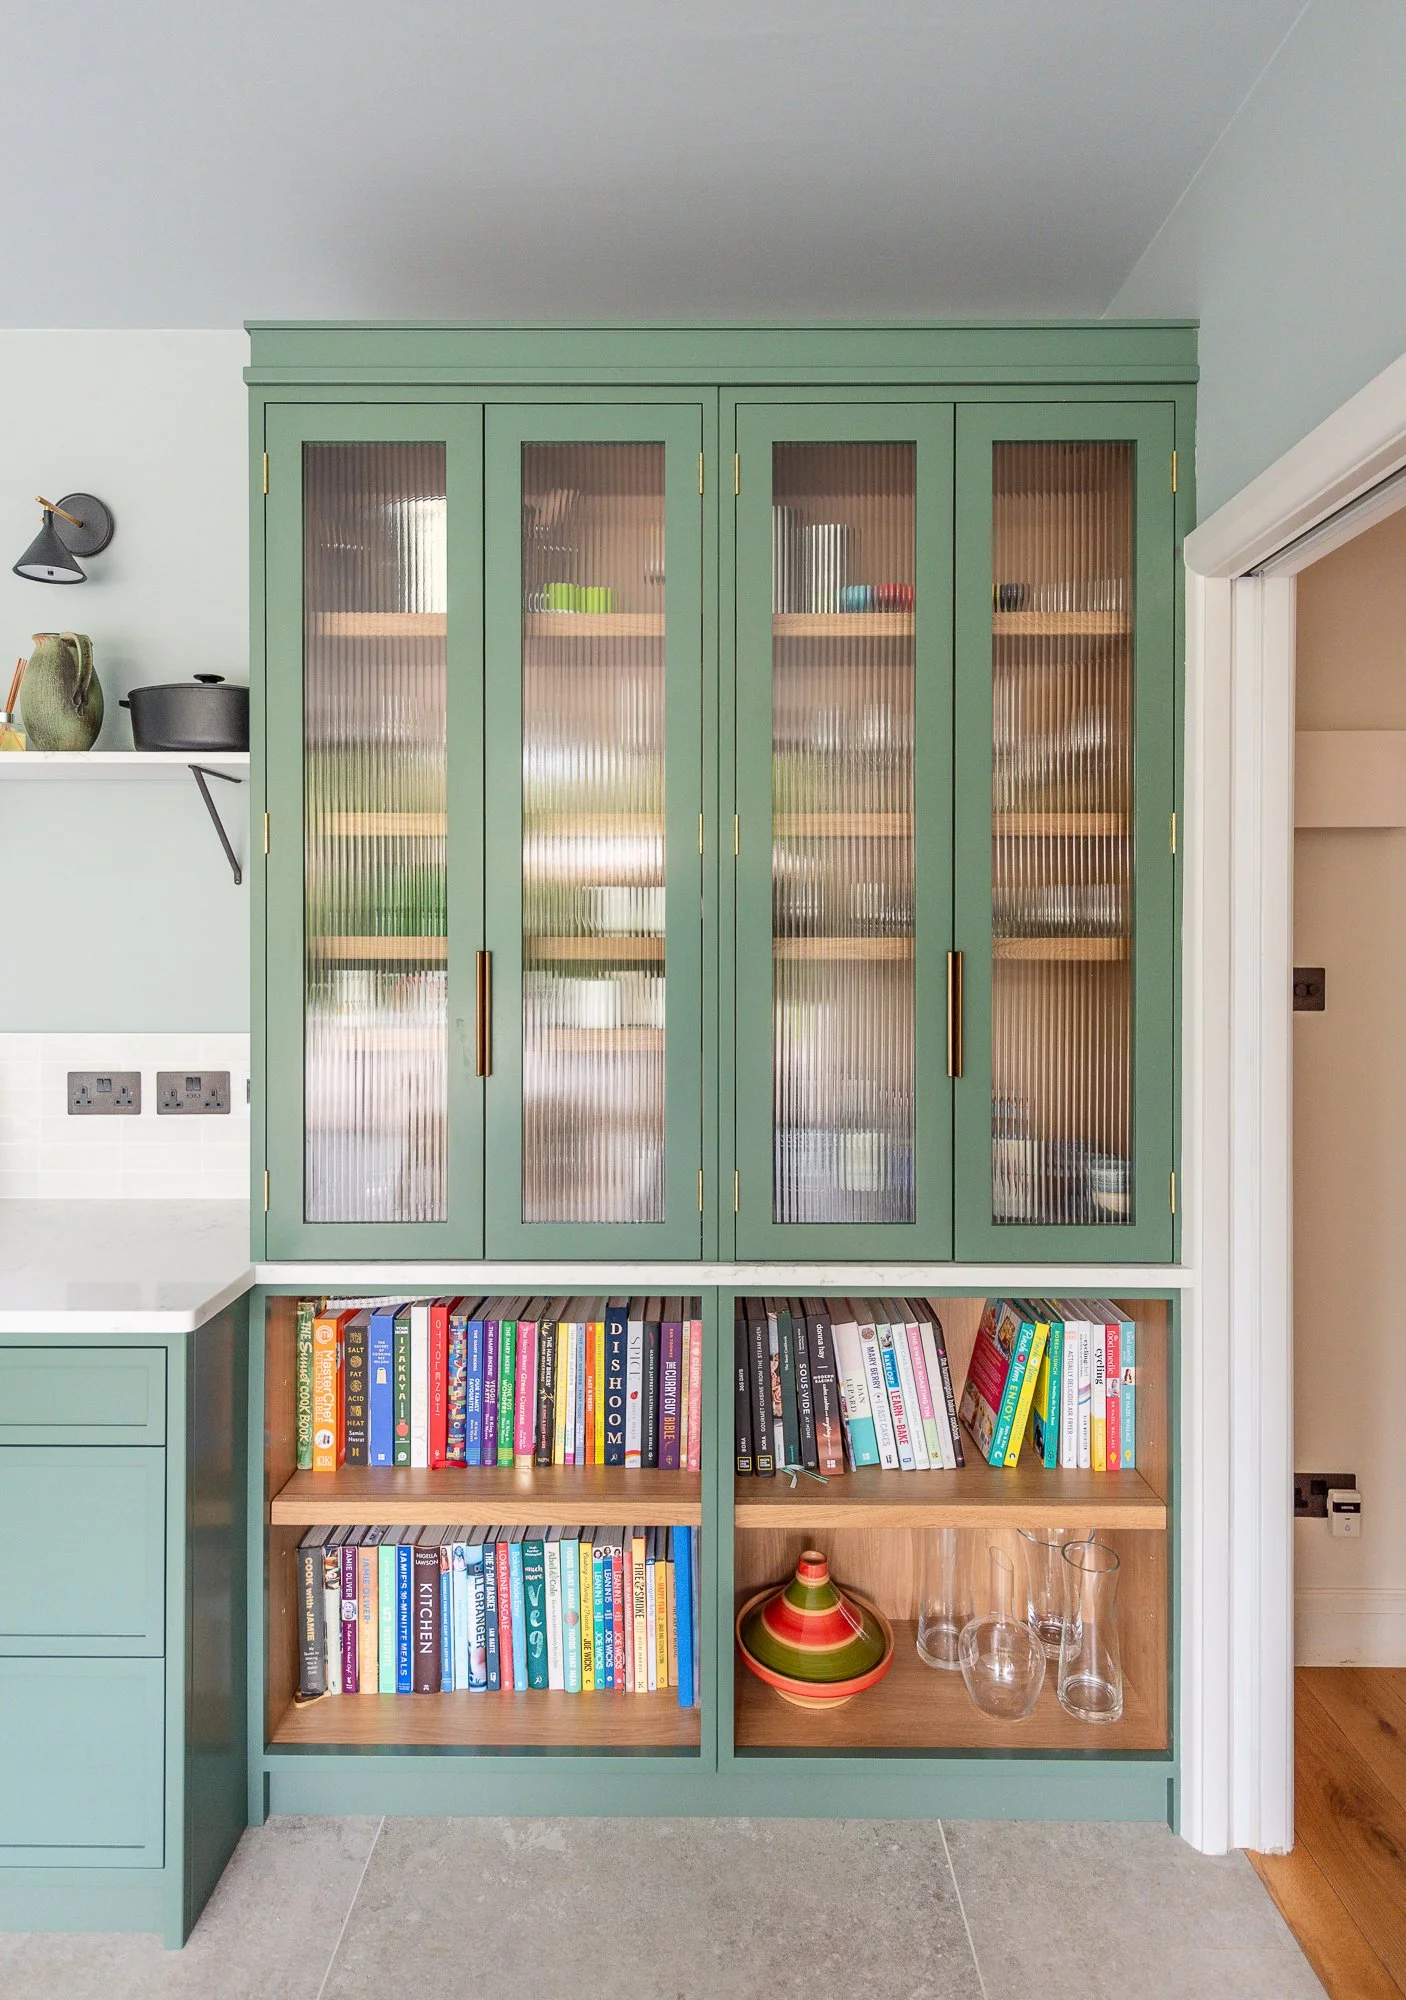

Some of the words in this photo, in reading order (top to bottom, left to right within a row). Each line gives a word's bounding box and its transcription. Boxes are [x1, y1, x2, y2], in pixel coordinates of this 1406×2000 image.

[301, 1321, 311, 1340] THE
[1018, 1329, 1032, 1352] Pinch
[1107, 1330, 1115, 1347] food
[818, 1346, 826, 1359] hay
[867, 1346, 877, 1366] MARY
[913, 1346, 923, 1369] SWEET
[1033, 1336, 1046, 1357] Pinch
[300, 1342, 312, 1383] Sunset
[884, 1354, 892, 1371] BAKE
[1012, 1362, 1023, 1382] Nom
[1095, 1348, 1105, 1385] cycling
[1108, 1349, 1116, 1374] medic
[607, 1323, 622, 1444] DISHOOM
[664, 1370, 676, 1397] CURRY
[870, 1367, 881, 1390] BERRY
[942, 1367, 953, 1398] hummingbird
[1026, 1366, 1038, 1383] Nom
[323, 1351, 334, 1423] MasterChef
[847, 1379, 857, 1413] LEPARD
[857, 1384, 865, 1404] DAN
[917, 1371, 928, 1404] ROASTING
[300, 1386, 309, 1413] COOK
[664, 1398, 676, 1415] GUY
[947, 1399, 957, 1416] bakery
[1006, 1386, 1018, 1422] ENJOY
[876, 1406, 885, 1423] FAST
[891, 1390, 903, 1417] LEARN
[897, 1424, 908, 1445] BAKE
[299, 1415, 309, 1441] BOOK
[664, 1417, 675, 1439] BIBLE
[880, 1424, 890, 1446] CAKES
[950, 1417, 961, 1441] cookbook
[317, 1456, 332, 1466] DK
[485, 1552, 494, 1565] THE
[512, 1551, 520, 1576] Baking
[548, 1551, 556, 1569] Abel
[305, 1558, 313, 1586] COOK
[363, 1557, 371, 1584] JAMIE
[486, 1566, 495, 1586] 7-DAY
[499, 1550, 507, 1591] LORRAINE
[635, 1563, 644, 1581] FIRE
[512, 1578, 520, 1597] Made
[635, 1581, 645, 1591] &
[363, 1587, 371, 1620] OLIVER
[487, 1587, 495, 1612] BASKET
[636, 1592, 645, 1618] SMOKE
[383, 1607, 392, 1622] 5
[420, 1583, 432, 1653] KITCHEN
[475, 1591, 486, 1649] GRANGER
[500, 1594, 508, 1630] PASCALE
[307, 1611, 315, 1641] JAMIE
